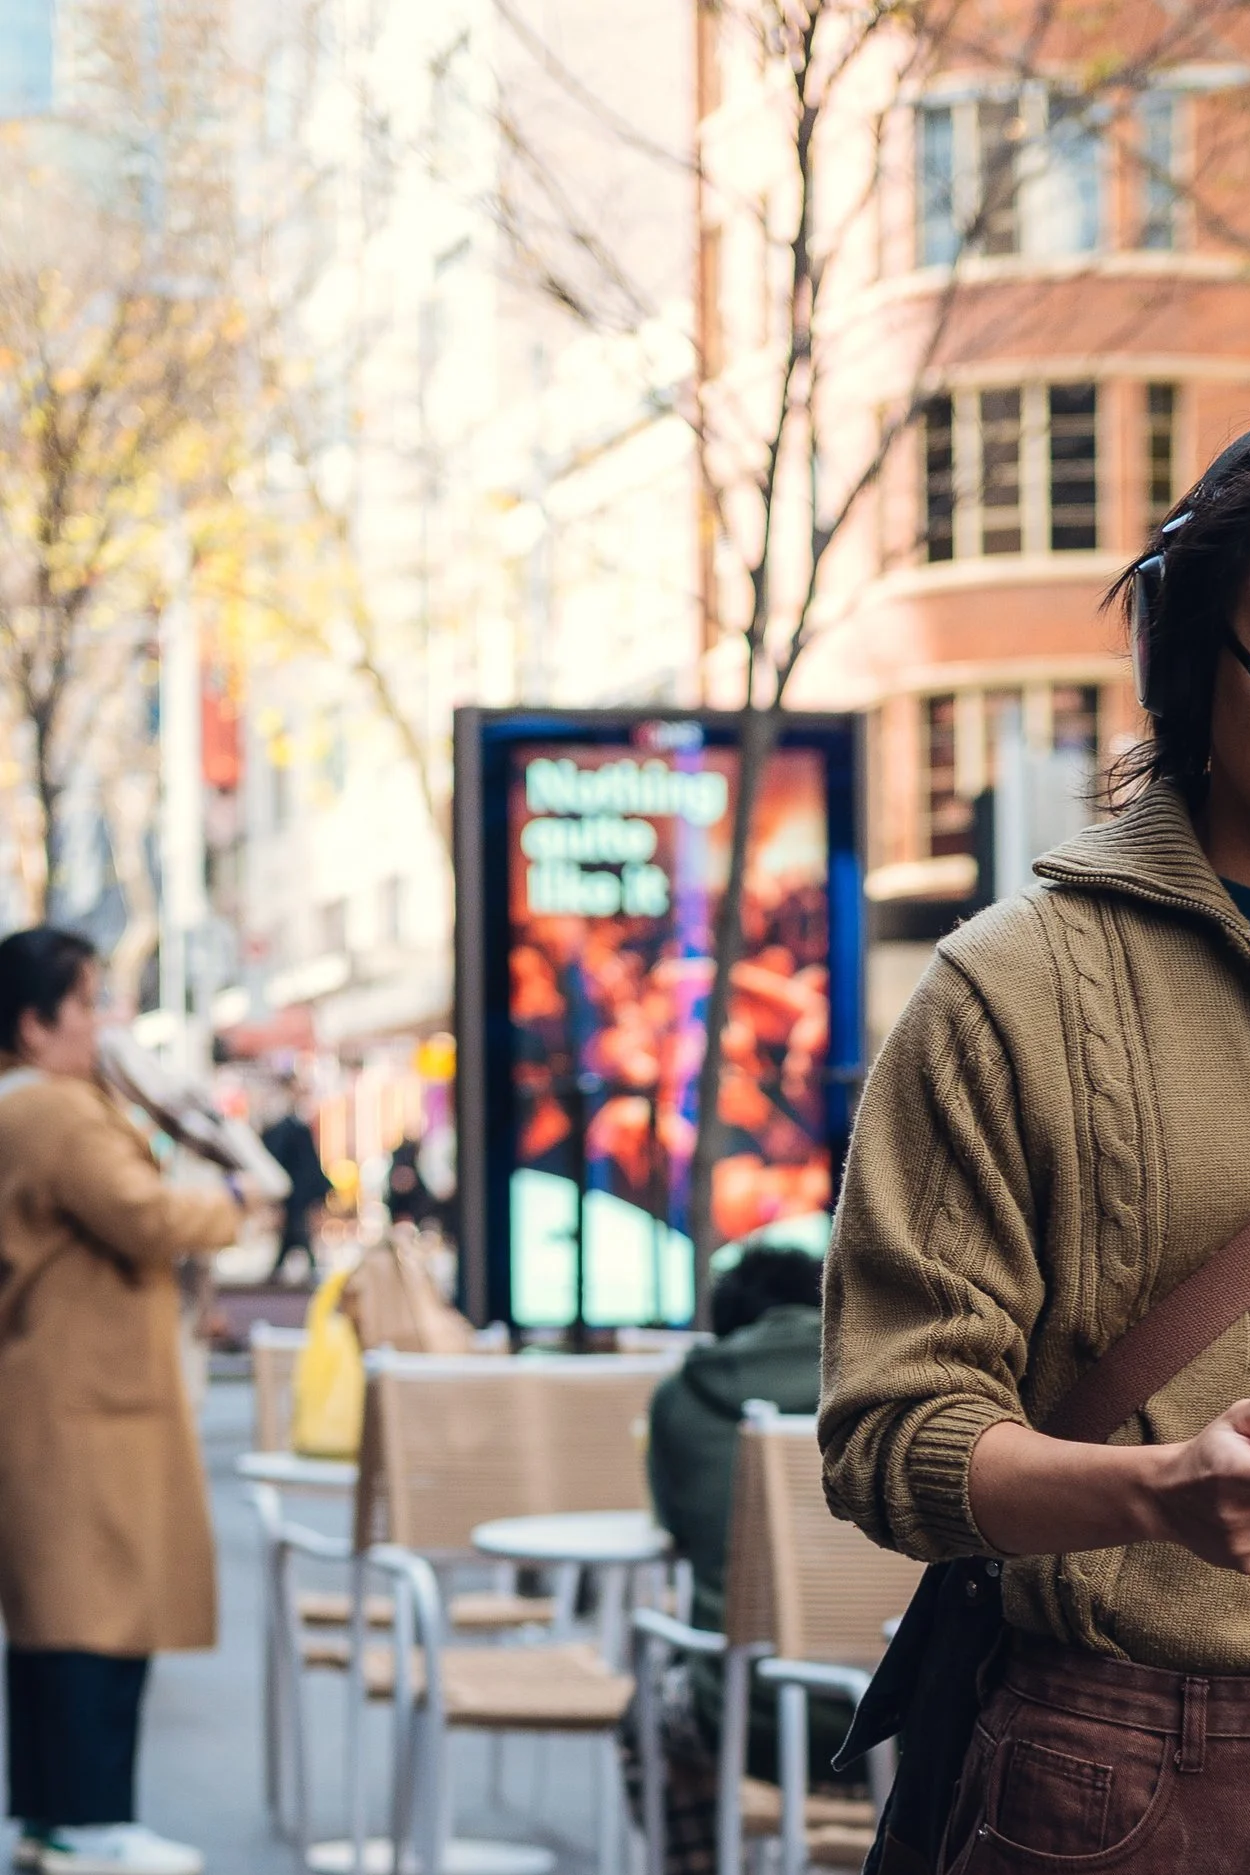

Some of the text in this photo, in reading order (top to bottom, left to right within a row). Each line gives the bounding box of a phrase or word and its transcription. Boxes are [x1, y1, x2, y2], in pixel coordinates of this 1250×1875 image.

[526, 758, 728, 828] Nothing
[526, 860, 670, 919] like it
